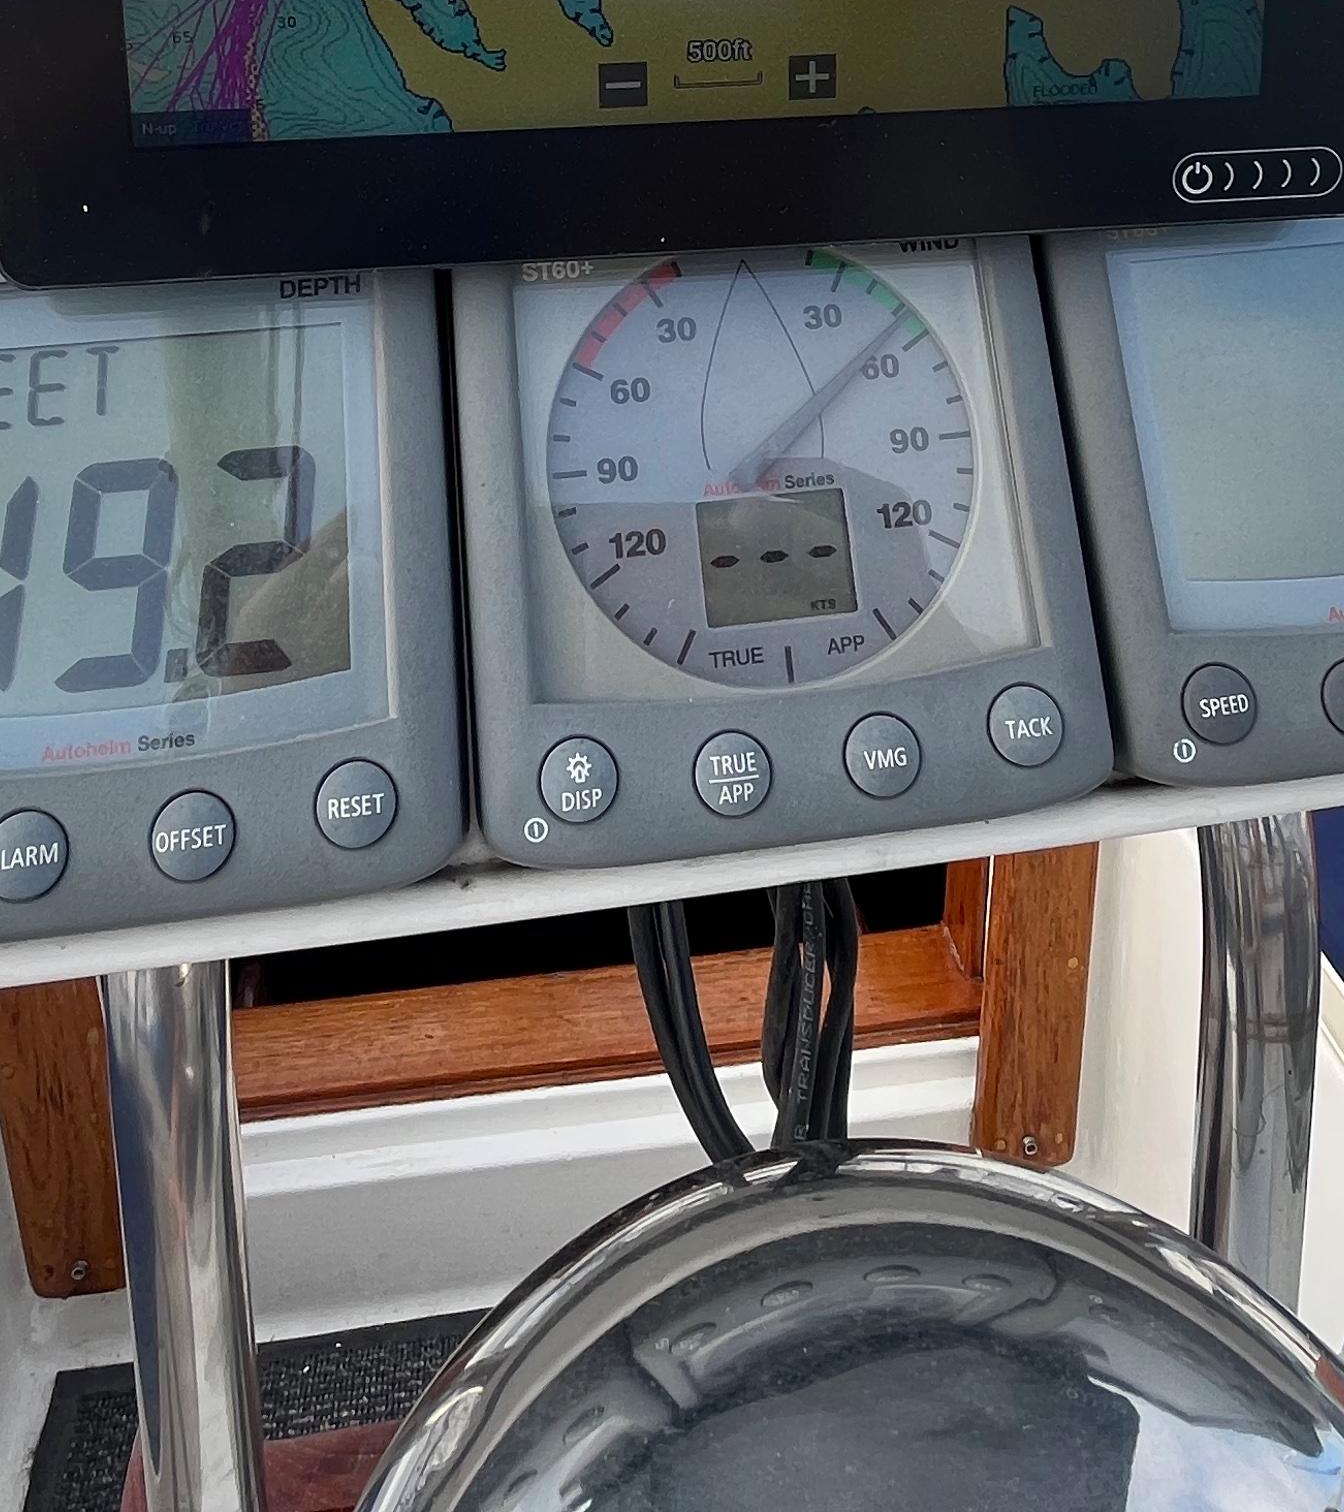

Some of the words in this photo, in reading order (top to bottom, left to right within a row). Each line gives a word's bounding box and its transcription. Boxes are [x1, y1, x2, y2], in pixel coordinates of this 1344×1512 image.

[687, 37, 753, 64] 500ft
[522, 259, 595, 282] ST60+
[280, 274, 361, 300] DEPTH
[656, 316, 697, 344] 30
[803, 303, 843, 330] 30
[860, 353, 900, 380] 60
[610, 377, 651, 404] 60
[889, 426, 930, 454] 90
[596, 455, 639, 483] 90
[784, 472, 835, 489] Series
[876, 499, 933, 529] 120
[608, 528, 667, 559] 120
[708, 646, 765, 670] TRUE
[827, 634, 866, 657] APP
[1199, 692, 1250, 720] SPEED
[1004, 715, 1054, 740] TACK
[41, 736, 132, 764] Autohelm
[136, 729, 196, 753] Series
[863, 746, 908, 770] VMG
[708, 751, 757, 777] TRUE
[326, 792, 386, 820] RESET
[560, 787, 603, 812] DISP
[718, 782, 755, 806] APP
[154, 822, 228, 853] OFFSET
